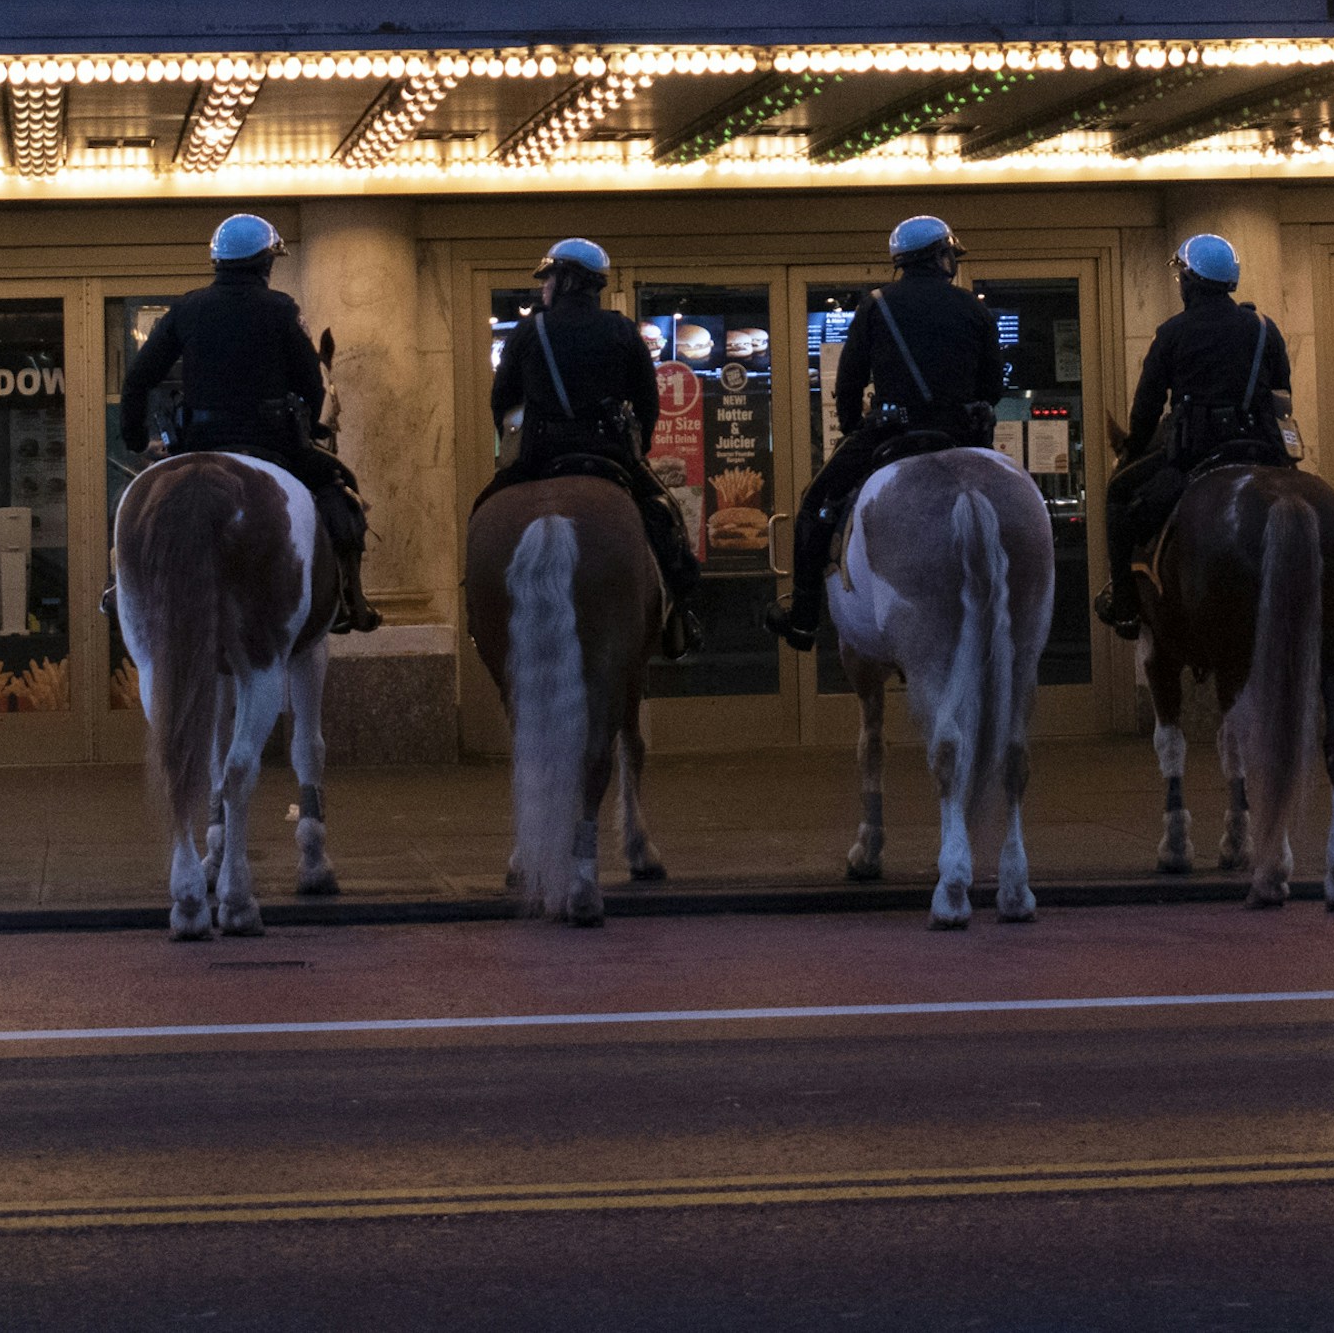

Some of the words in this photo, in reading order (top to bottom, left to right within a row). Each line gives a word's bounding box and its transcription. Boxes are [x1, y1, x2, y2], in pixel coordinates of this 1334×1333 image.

[722, 395, 747, 406] NEW!
[716, 409, 753, 421] Hotter
[655, 419, 672, 433] ny
[675, 417, 701, 431] Size
[730, 422, 740, 435] &
[655, 433, 673, 444] Soft
[674, 433, 698, 444] Drink
[715, 435, 756, 449] Juicier
